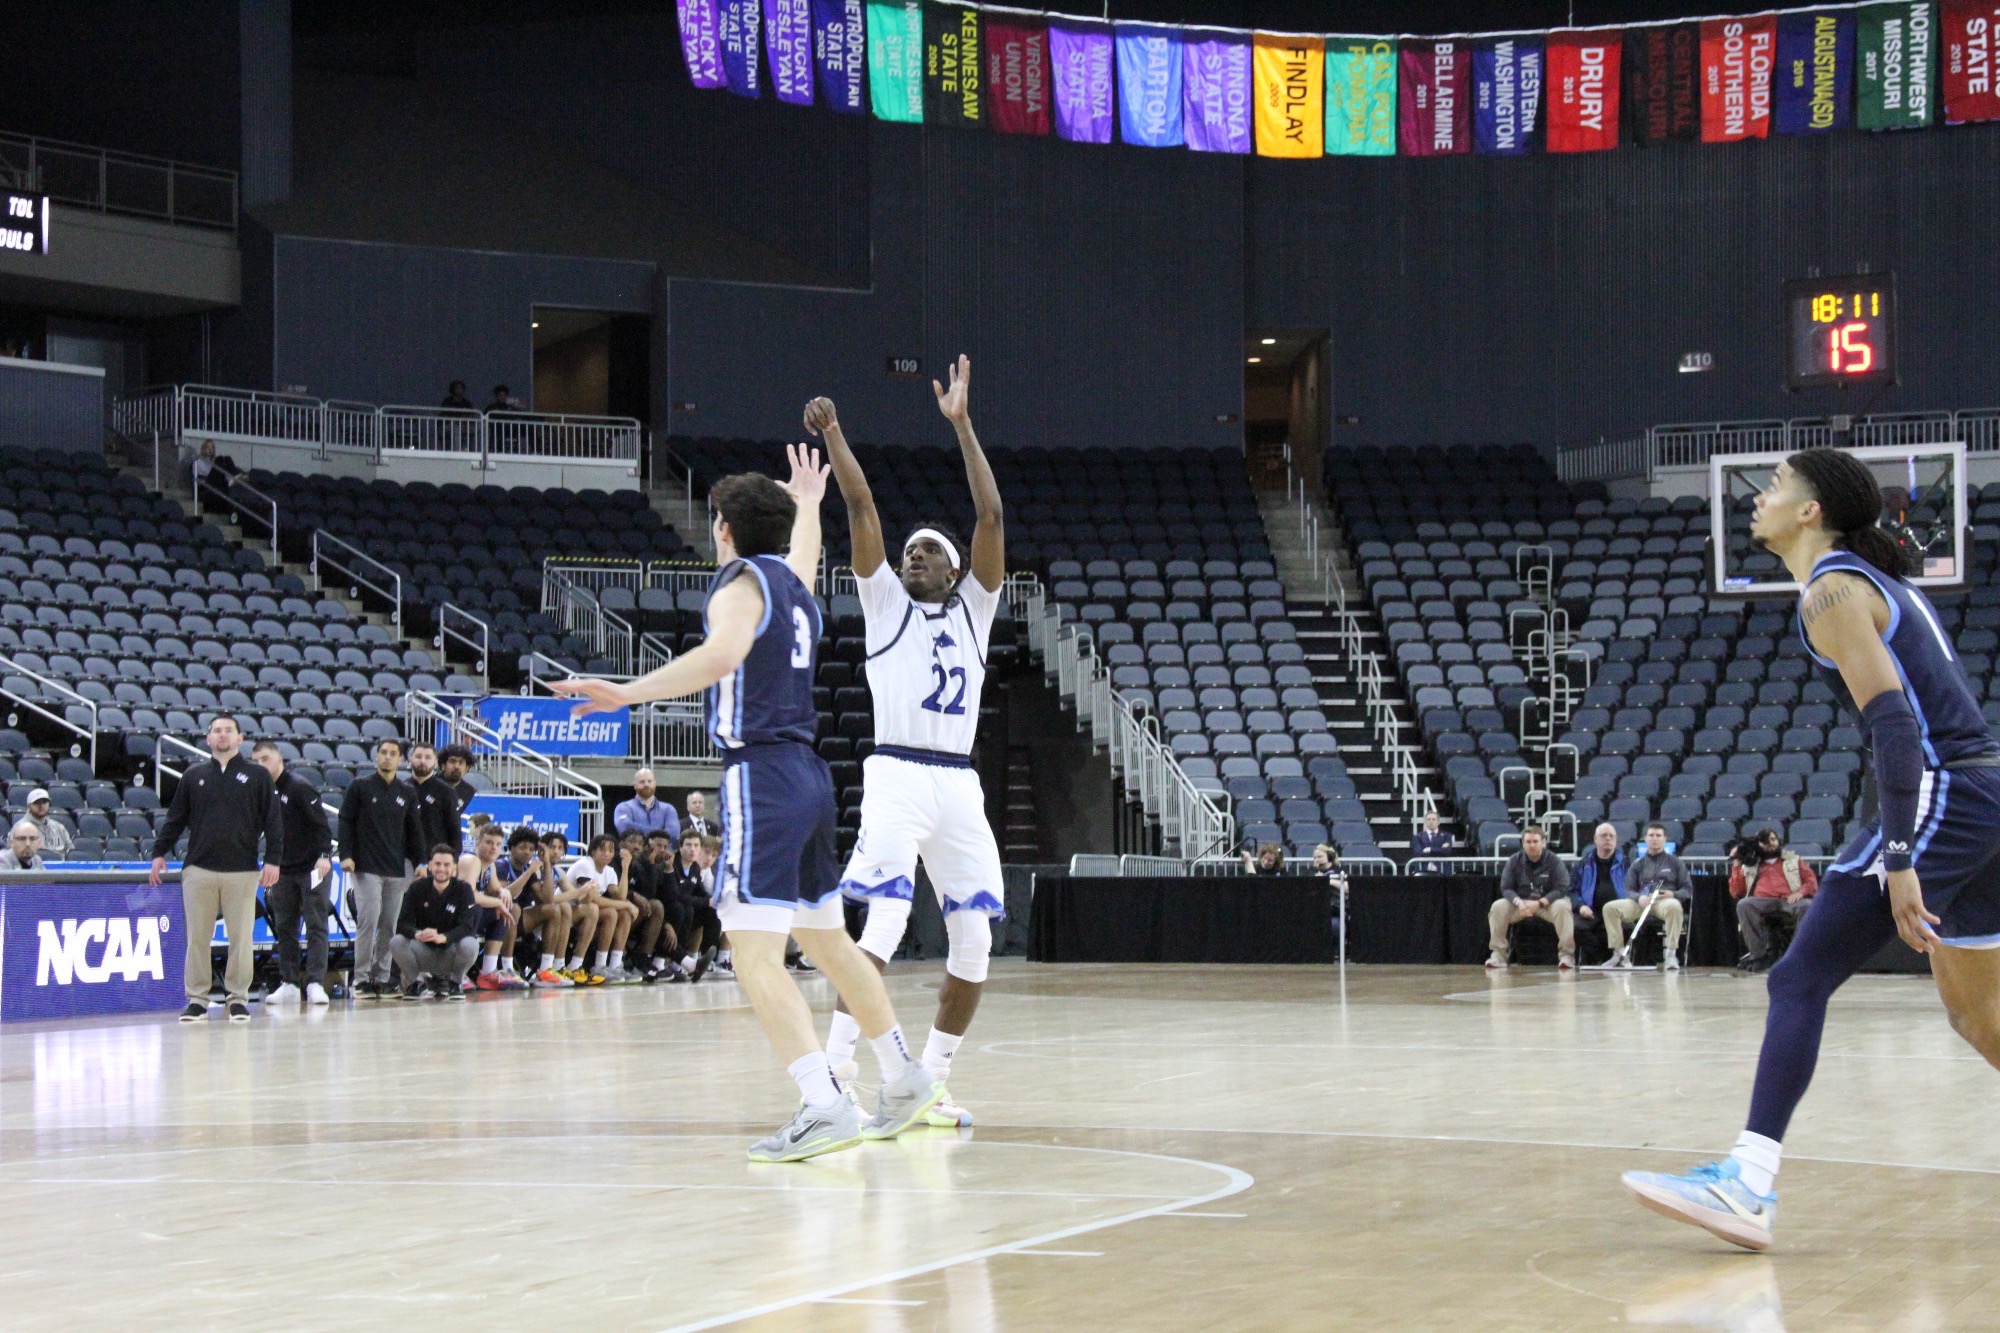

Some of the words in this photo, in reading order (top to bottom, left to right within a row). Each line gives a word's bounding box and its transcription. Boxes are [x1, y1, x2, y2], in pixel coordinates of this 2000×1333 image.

[728, 2, 742, 53] STATE
[742, 0, 760, 89] ROPOLITAN
[827, 22, 844, 71] STATE
[886, 35, 902, 77] STATE
[1966, 18, 1989, 94] STATE
[905, 2, 922, 115] NORTHEASTERN
[928, 44, 938, 76] 2004
[942, 33, 957, 93] STATE
[962, 11, 979, 120] KENNESAW
[1005, 42, 1022, 100] UNION
[1026, 35, 1042, 113] VIRGINIA
[1068, 51, 1086, 108] STATE
[1090, 45, 1108, 119] WINONA
[1146, 37, 1169, 135] BARTON
[1372, 42, 1391, 84] CAL
[1708, 65, 1719, 95] 2015
[1723, 22, 1744, 135] SOUTHERN
[1750, 32, 1769, 121] FLORIDA
[1866, 51, 1877, 81] 2017
[1883, 19, 1902, 110] MISSOURI
[1908, 3, 1930, 120] NORTHWEST
[1950, 43, 1962, 74] 2018
[1205, 54, 1223, 126] STATE
[1227, 43, 1245, 139] WINONA
[1269, 82, 1279, 108] 2009
[1285, 47, 1308, 144] FINDLAY
[1347, 45, 1368, 144] POMONA
[1416, 84, 1427, 109] 2011
[1434, 43, 1454, 150] BELLARMINE
[1479, 82, 1490, 109] 2012
[1494, 40, 1515, 149] WASHINGTON
[1520, 52, 1540, 133] WESTERN
[1563, 76, 1574, 104] 2013
[1578, 47, 1605, 130] DRURY
[1372, 91, 1391, 148] POLY
[9, 196, 34, 219] TOL
[1812, 292, 1879, 323] 18:11
[893, 358, 917, 373] 109
[1684, 352, 1712, 368] 110
[1830, 322, 1872, 373] 15
[790, 605, 812, 669] 3
[920, 663, 967, 716] 22
[498, 711, 622, 743] #ELITEEIGHT
[36, 917, 165, 986] NCAA
